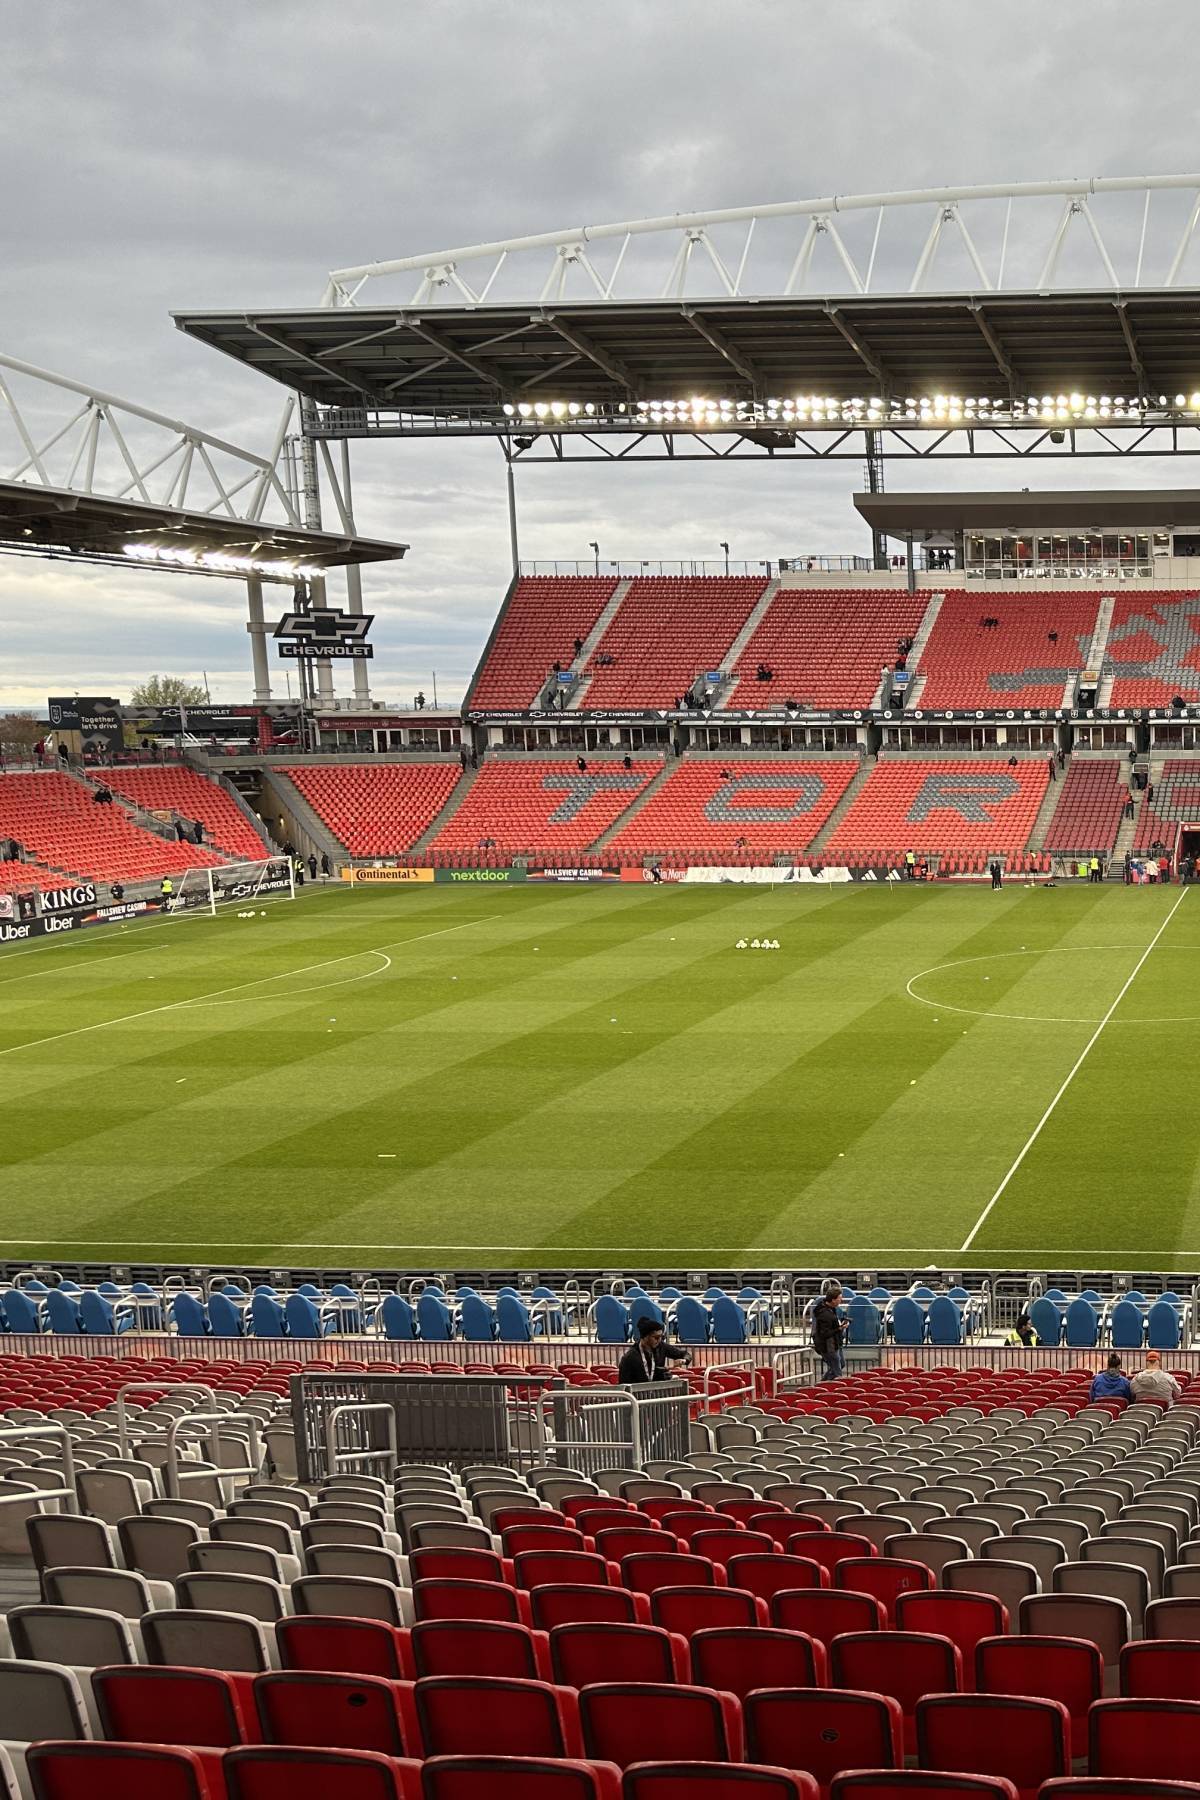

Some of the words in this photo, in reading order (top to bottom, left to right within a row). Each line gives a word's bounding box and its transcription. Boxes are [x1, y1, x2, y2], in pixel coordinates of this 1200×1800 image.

[282, 646, 370, 656] CHEVROLET
[356, 869, 410, 880] Continental
[451, 869, 509, 880] nextdoor
[252, 879, 291, 891] CHEVROLE
[40, 884, 95, 911] KINGS
[97, 905, 126, 918] FALLSVIEW
[127, 901, 147, 912] CASINO
[44, 917, 74, 932] Uber
[0, 924, 30, 941] Uber
